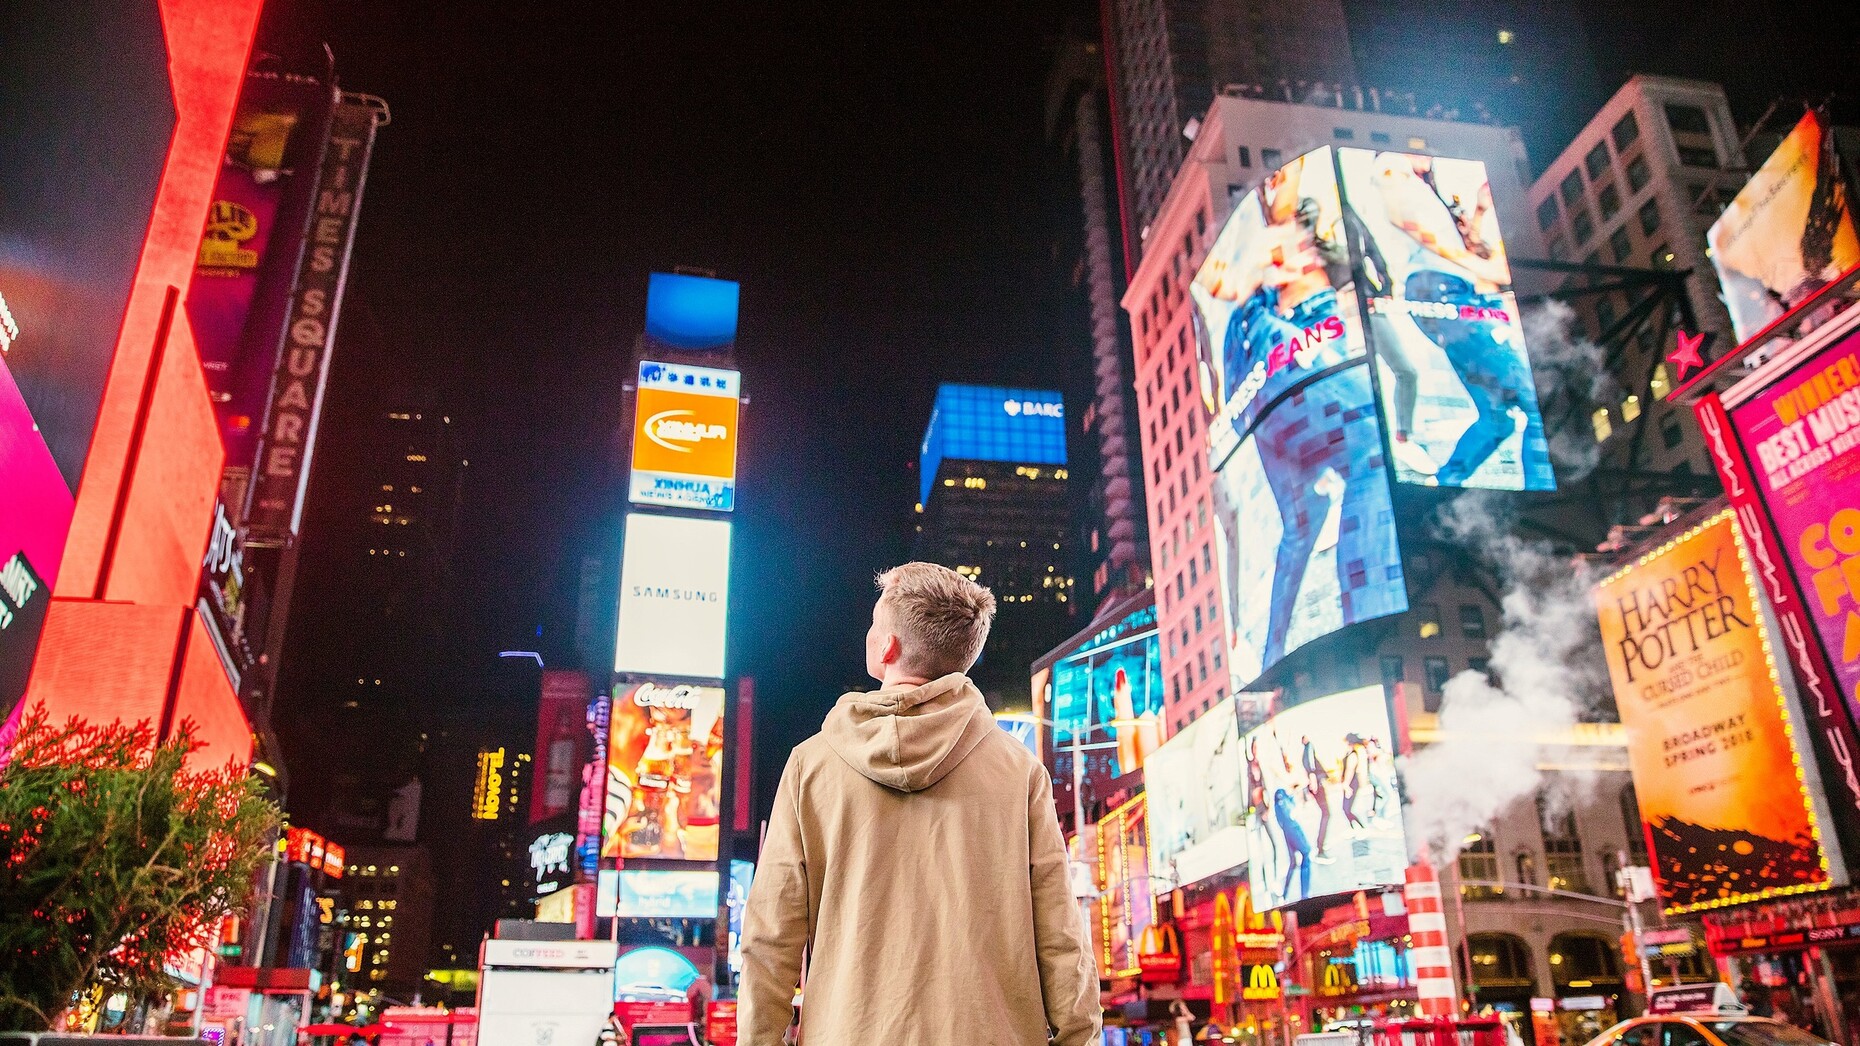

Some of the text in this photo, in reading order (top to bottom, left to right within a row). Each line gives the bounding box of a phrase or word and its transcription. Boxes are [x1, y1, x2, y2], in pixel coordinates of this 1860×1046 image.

[267, 138, 361, 478] TIMES SQUARE
[1266, 315, 1346, 379] JEANS
[1022, 401, 1065, 418] BARC
[1755, 419, 1812, 475] BEST
[632, 585, 719, 603] SAMSUNG
[1617, 546, 1723, 639] HARRY
[1618, 594, 1751, 683] POTTER
[1697, 649, 1744, 678] CHILD
[1662, 713, 1746, 751] BROADWAY
[1664, 742, 1717, 769] SPRING
[482, 746, 505, 820] NOVOTEL
[1809, 926, 1845, 941] SONY
